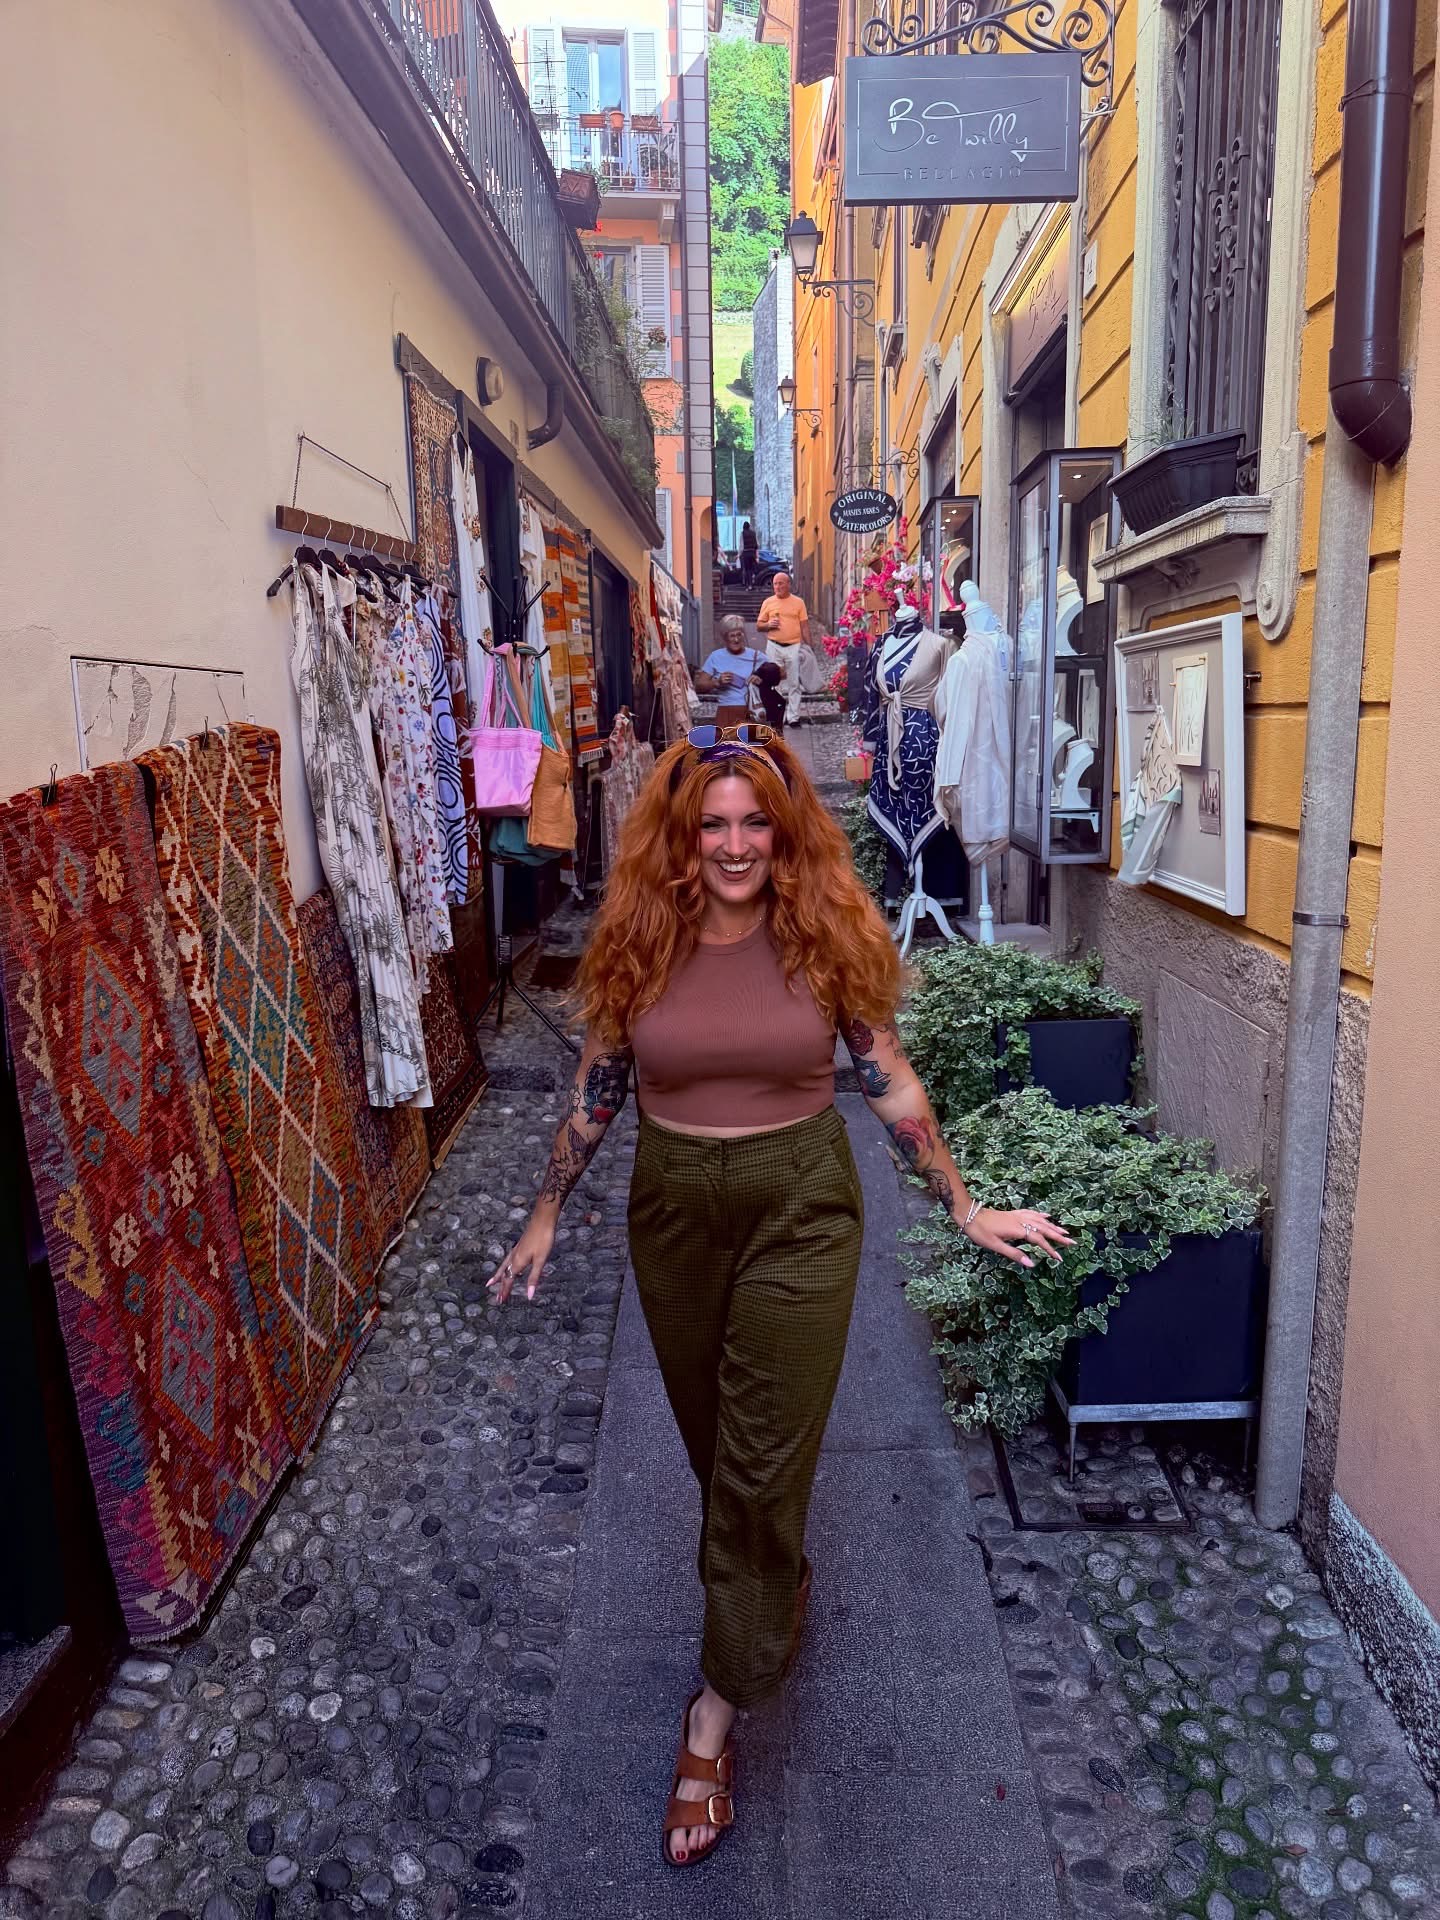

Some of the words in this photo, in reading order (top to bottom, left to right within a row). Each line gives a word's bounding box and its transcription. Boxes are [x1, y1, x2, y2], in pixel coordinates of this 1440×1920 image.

[903, 165, 1022, 181] BELLAGIO
[838, 491, 887, 508] ORIGINAL
[837, 513, 892, 532] WATERCOLORS
